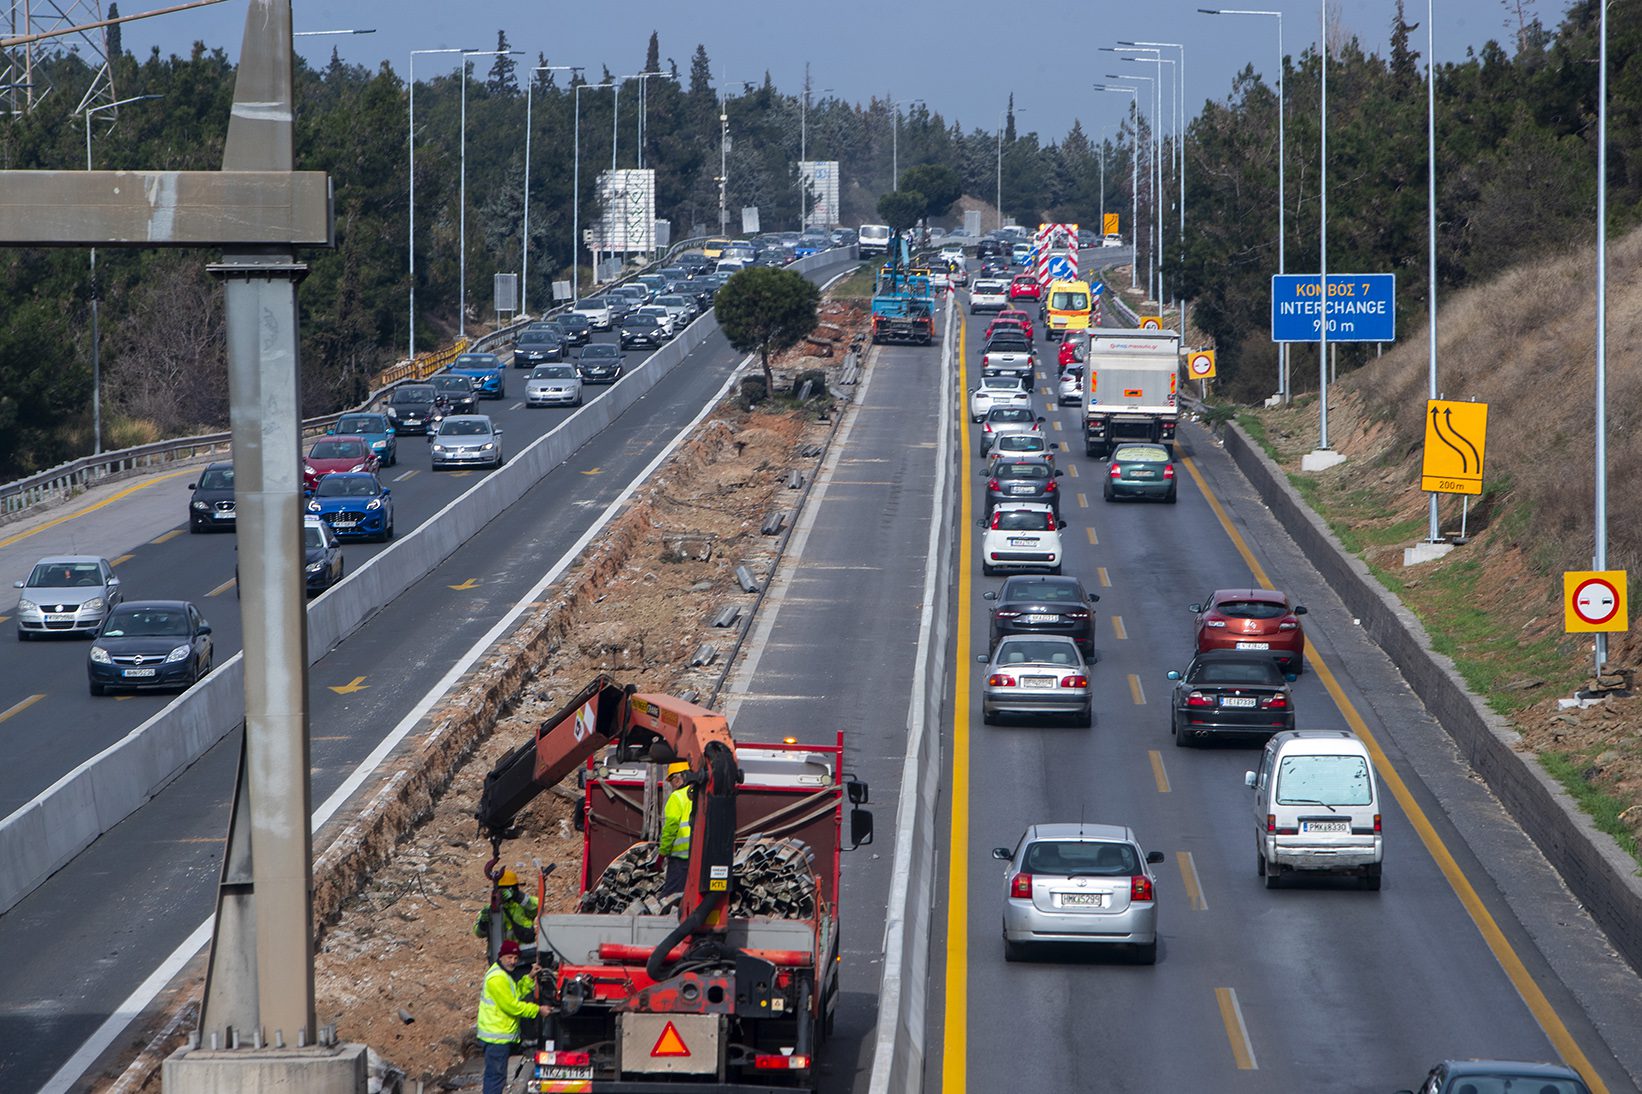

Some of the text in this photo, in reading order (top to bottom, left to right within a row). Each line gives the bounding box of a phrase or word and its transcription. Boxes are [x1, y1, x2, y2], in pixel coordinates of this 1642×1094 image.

[1361, 283, 1370, 296] 7
[1280, 301, 1386, 314] INTERCHANGE
[1341, 322, 1354, 332] m
